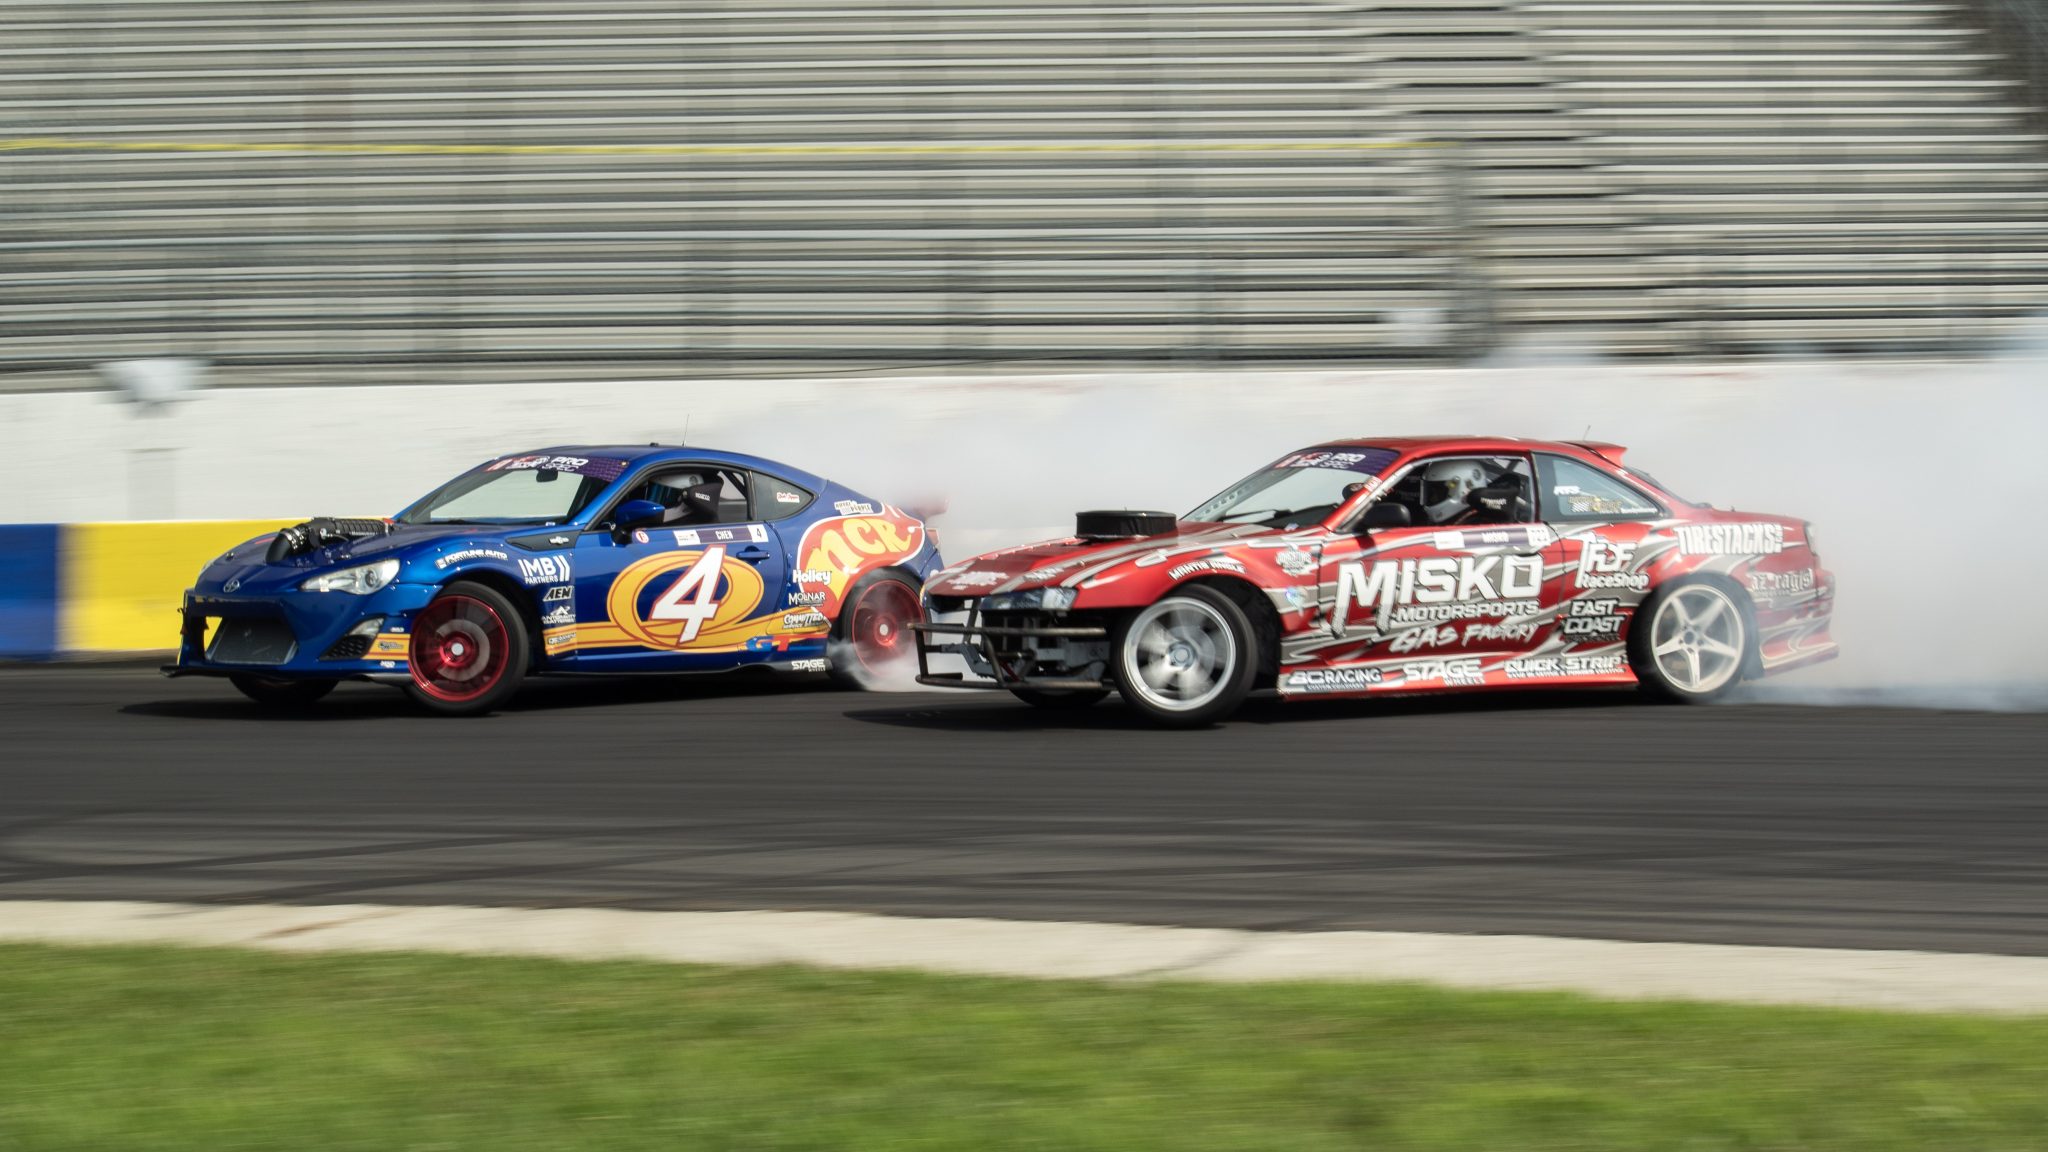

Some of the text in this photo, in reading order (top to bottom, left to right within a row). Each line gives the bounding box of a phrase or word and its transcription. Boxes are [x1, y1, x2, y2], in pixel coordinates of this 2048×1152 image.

[550, 456, 588, 466] PRO
[715, 530, 734, 541] CHEN
[1674, 524, 1775, 555] TIRESTACKS
[445, 550, 485, 566] FORTUNE
[485, 549, 508, 560] AUTO
[525, 575, 559, 585] PARTNERS
[792, 569, 831, 586] Holley
[1582, 571, 1649, 591] RaceShop
[650, 545, 727, 644] 4
[788, 592, 826, 606] MOLNAR
[1331, 553, 1544, 639] MISKO
[1397, 600, 1541, 623] MOTORSPORTS
[1571, 600, 1618, 616] EAST
[1564, 617, 1625, 635] COAST
[1389, 621, 1541, 653] GAS FACTORY
[791, 659, 825, 671] STAGE
[1403, 659, 1483, 681] STAGE
[1504, 656, 1620, 673] QUICK STRIP
